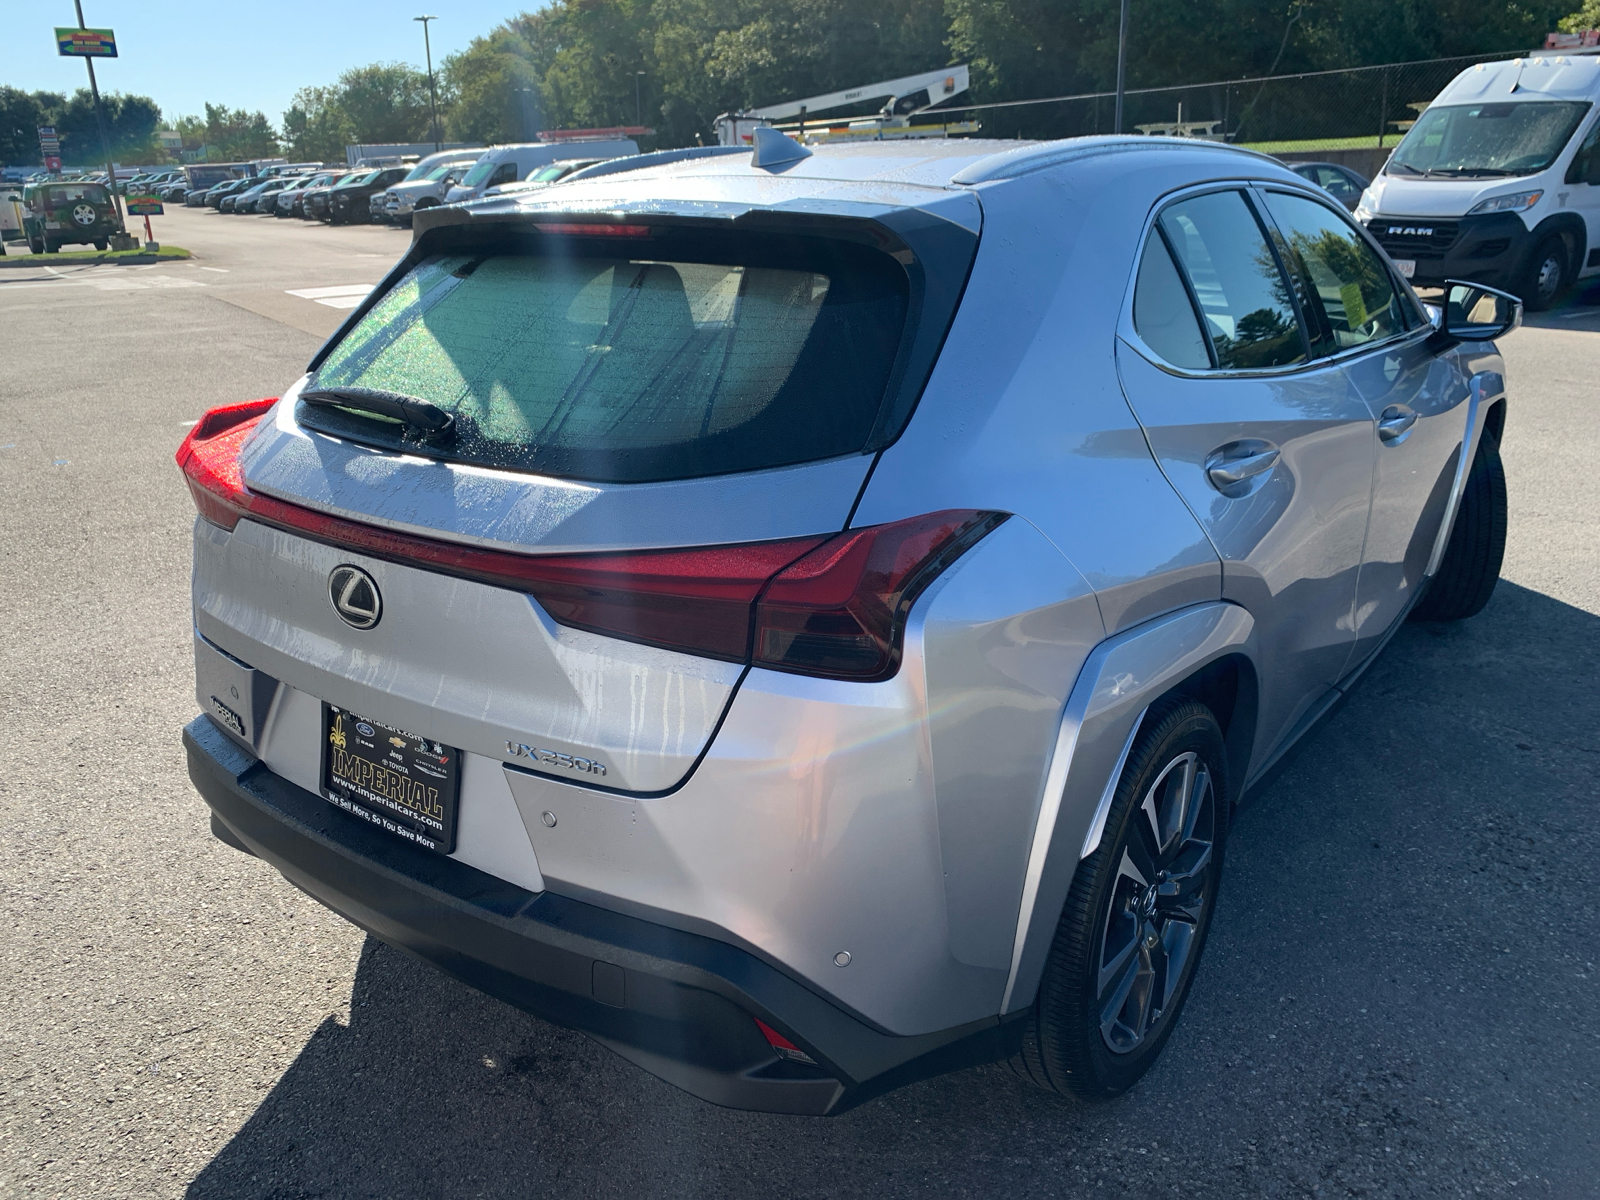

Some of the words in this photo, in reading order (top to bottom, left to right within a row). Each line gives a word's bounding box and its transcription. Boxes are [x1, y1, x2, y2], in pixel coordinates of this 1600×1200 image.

[1388, 227, 1433, 236] RAM
[360, 740, 375, 749] RAM
[389, 750, 403, 762] Jeep
[389, 761, 409, 775] TOYOTA
[333, 746, 443, 820] IMPERIAL
[332, 775, 443, 831] www.imperialcars.com
[328, 792, 339, 804] We
[340, 798, 352, 810] Sell
[352, 804, 371, 822] More,
[372, 814, 381, 825] So
[382, 818, 396, 832] You
[397, 825, 415, 841] Save
[416, 834, 435, 850] More
